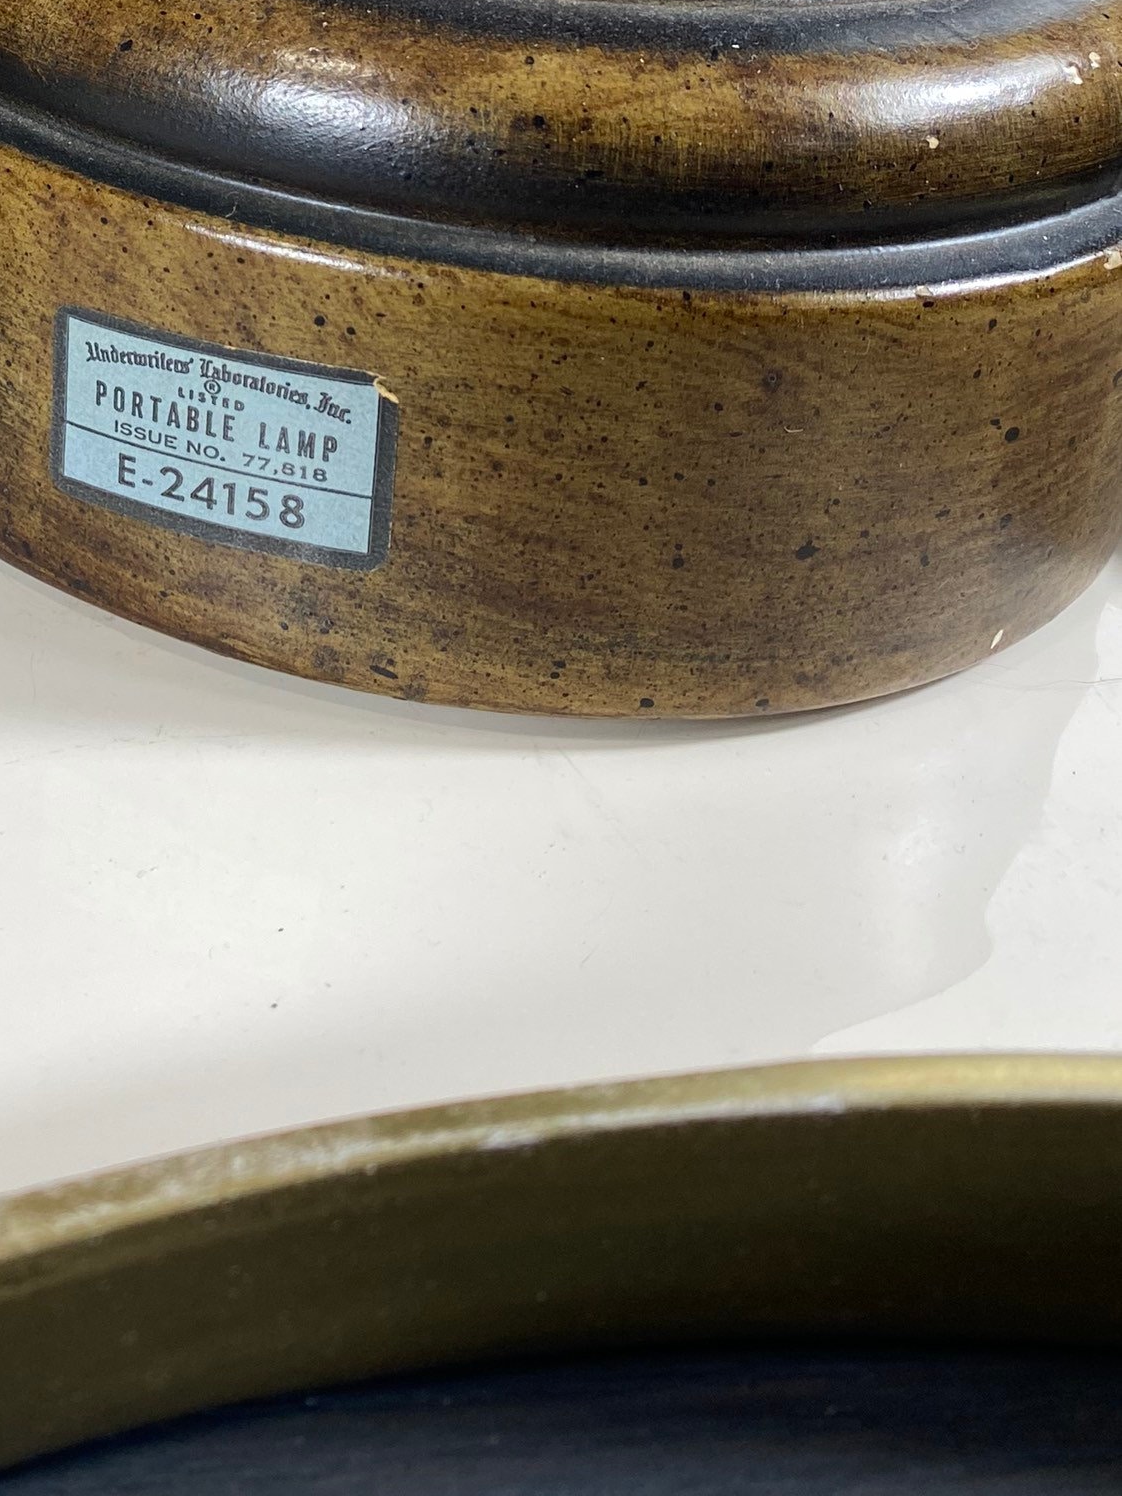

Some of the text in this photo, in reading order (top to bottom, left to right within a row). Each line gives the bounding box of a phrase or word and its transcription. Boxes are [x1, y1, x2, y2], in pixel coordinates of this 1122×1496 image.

[96, 380, 338, 462] PORTABLE LAMP
[178, 386, 245, 411] LISTED
[199, 358, 311, 410] Laboratories,
[313, 392, 352, 424] Inc.
[114, 420, 177, 449] ISSUE
[186, 440, 226, 462] NO.
[118, 452, 305, 529] E-24158
